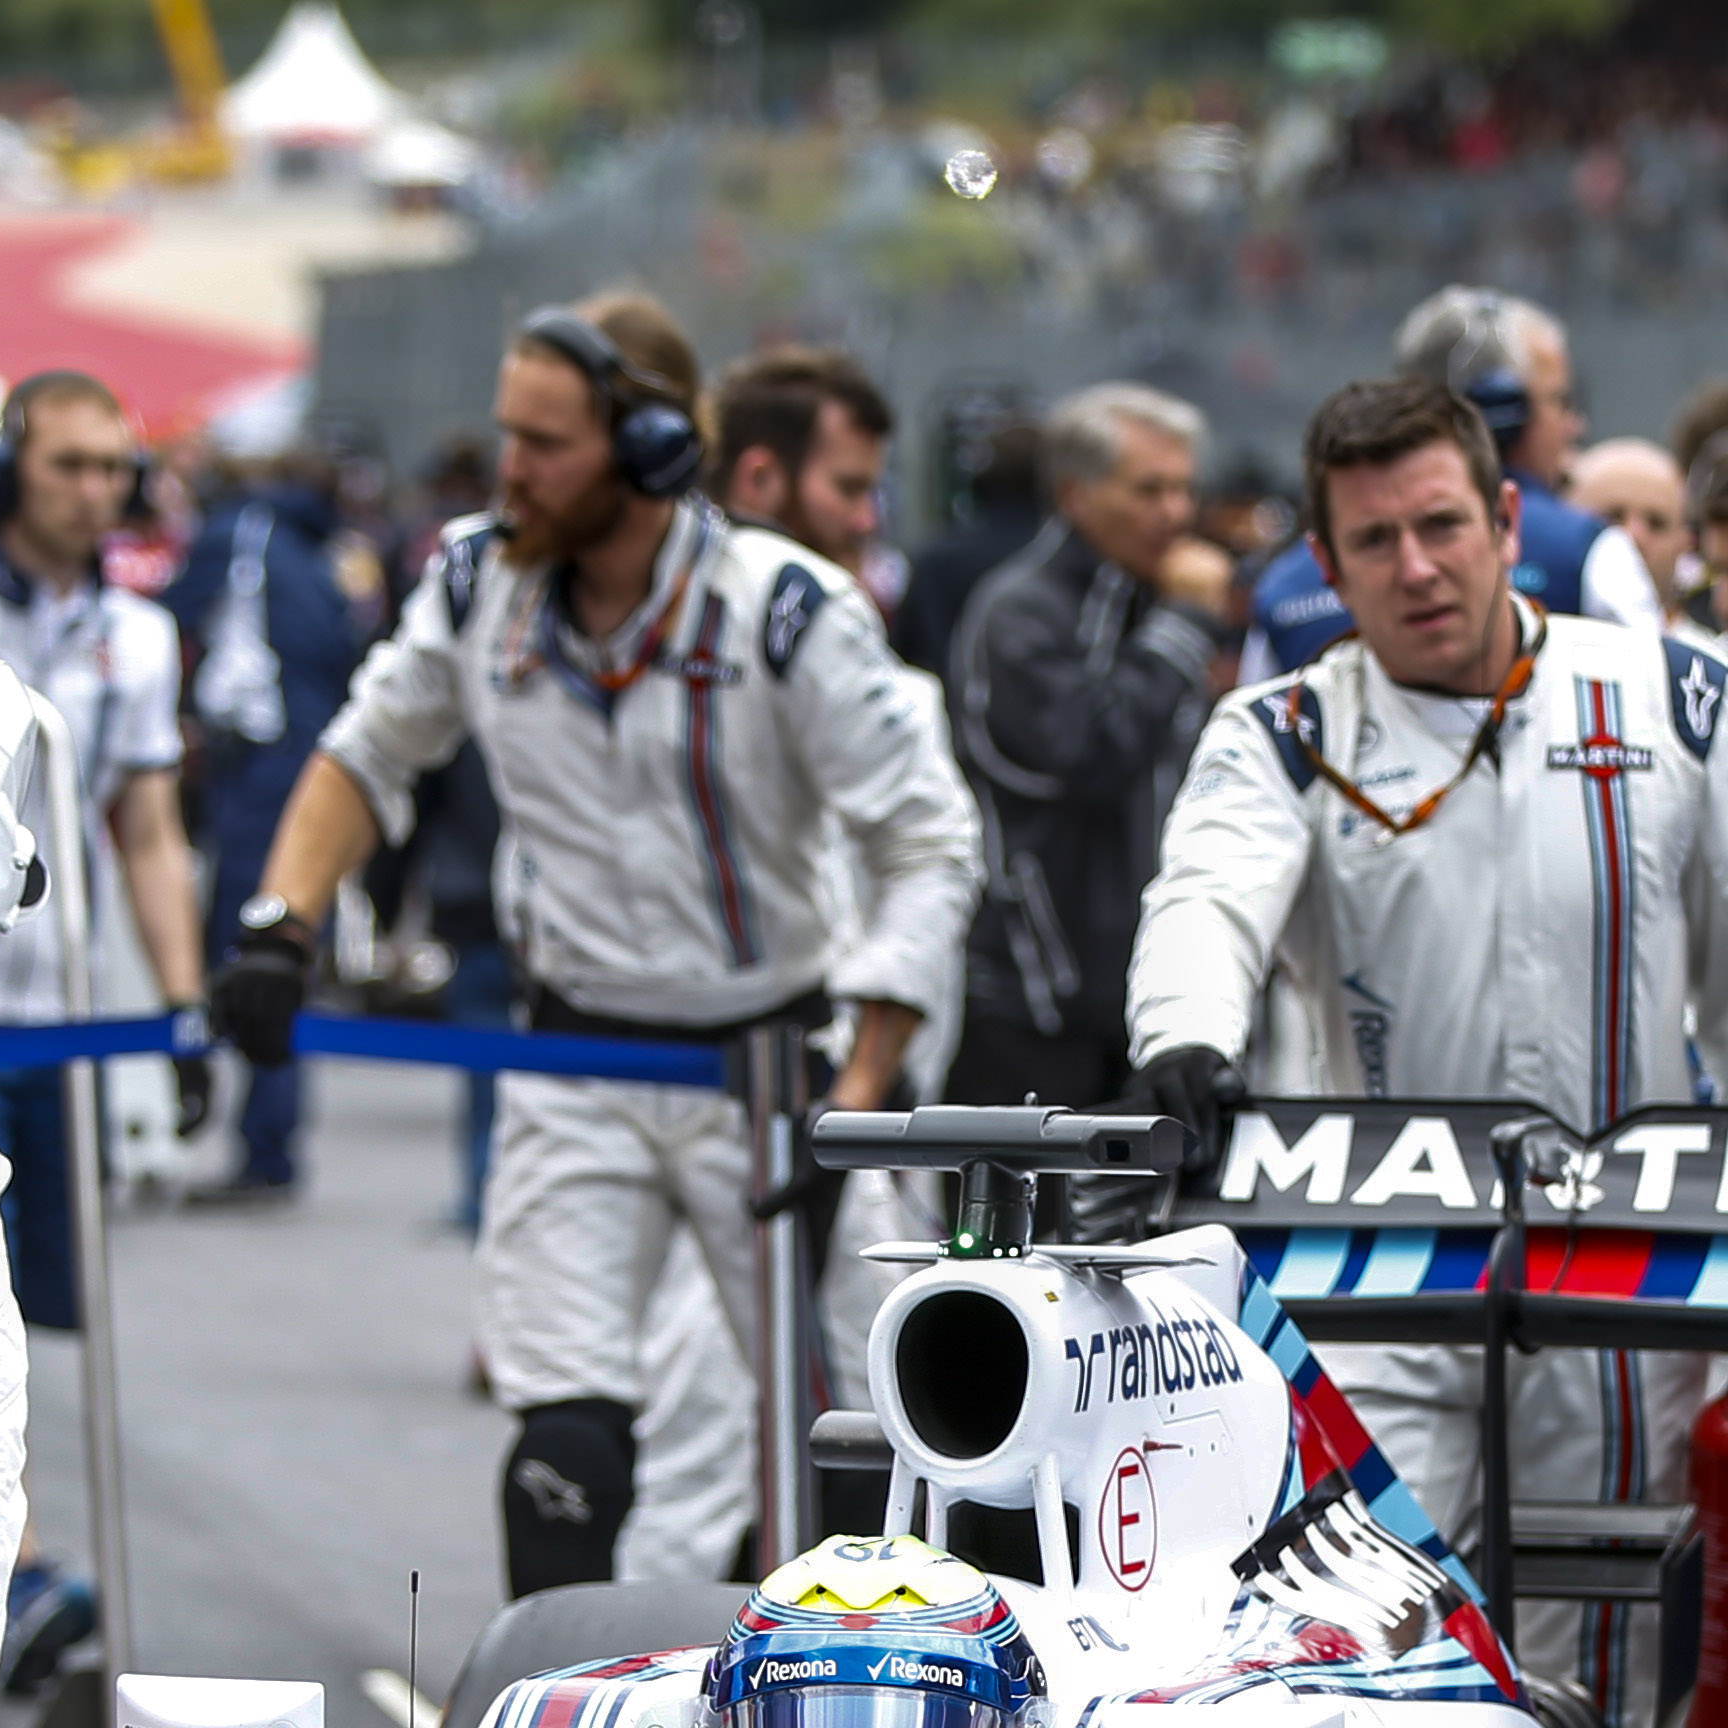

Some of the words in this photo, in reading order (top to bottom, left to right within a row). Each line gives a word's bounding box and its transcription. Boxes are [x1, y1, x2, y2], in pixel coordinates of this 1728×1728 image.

[1107, 1296, 1243, 1404] randstad
[766, 1659, 837, 1683] Rexona
[890, 1656, 964, 1687] Rexona
